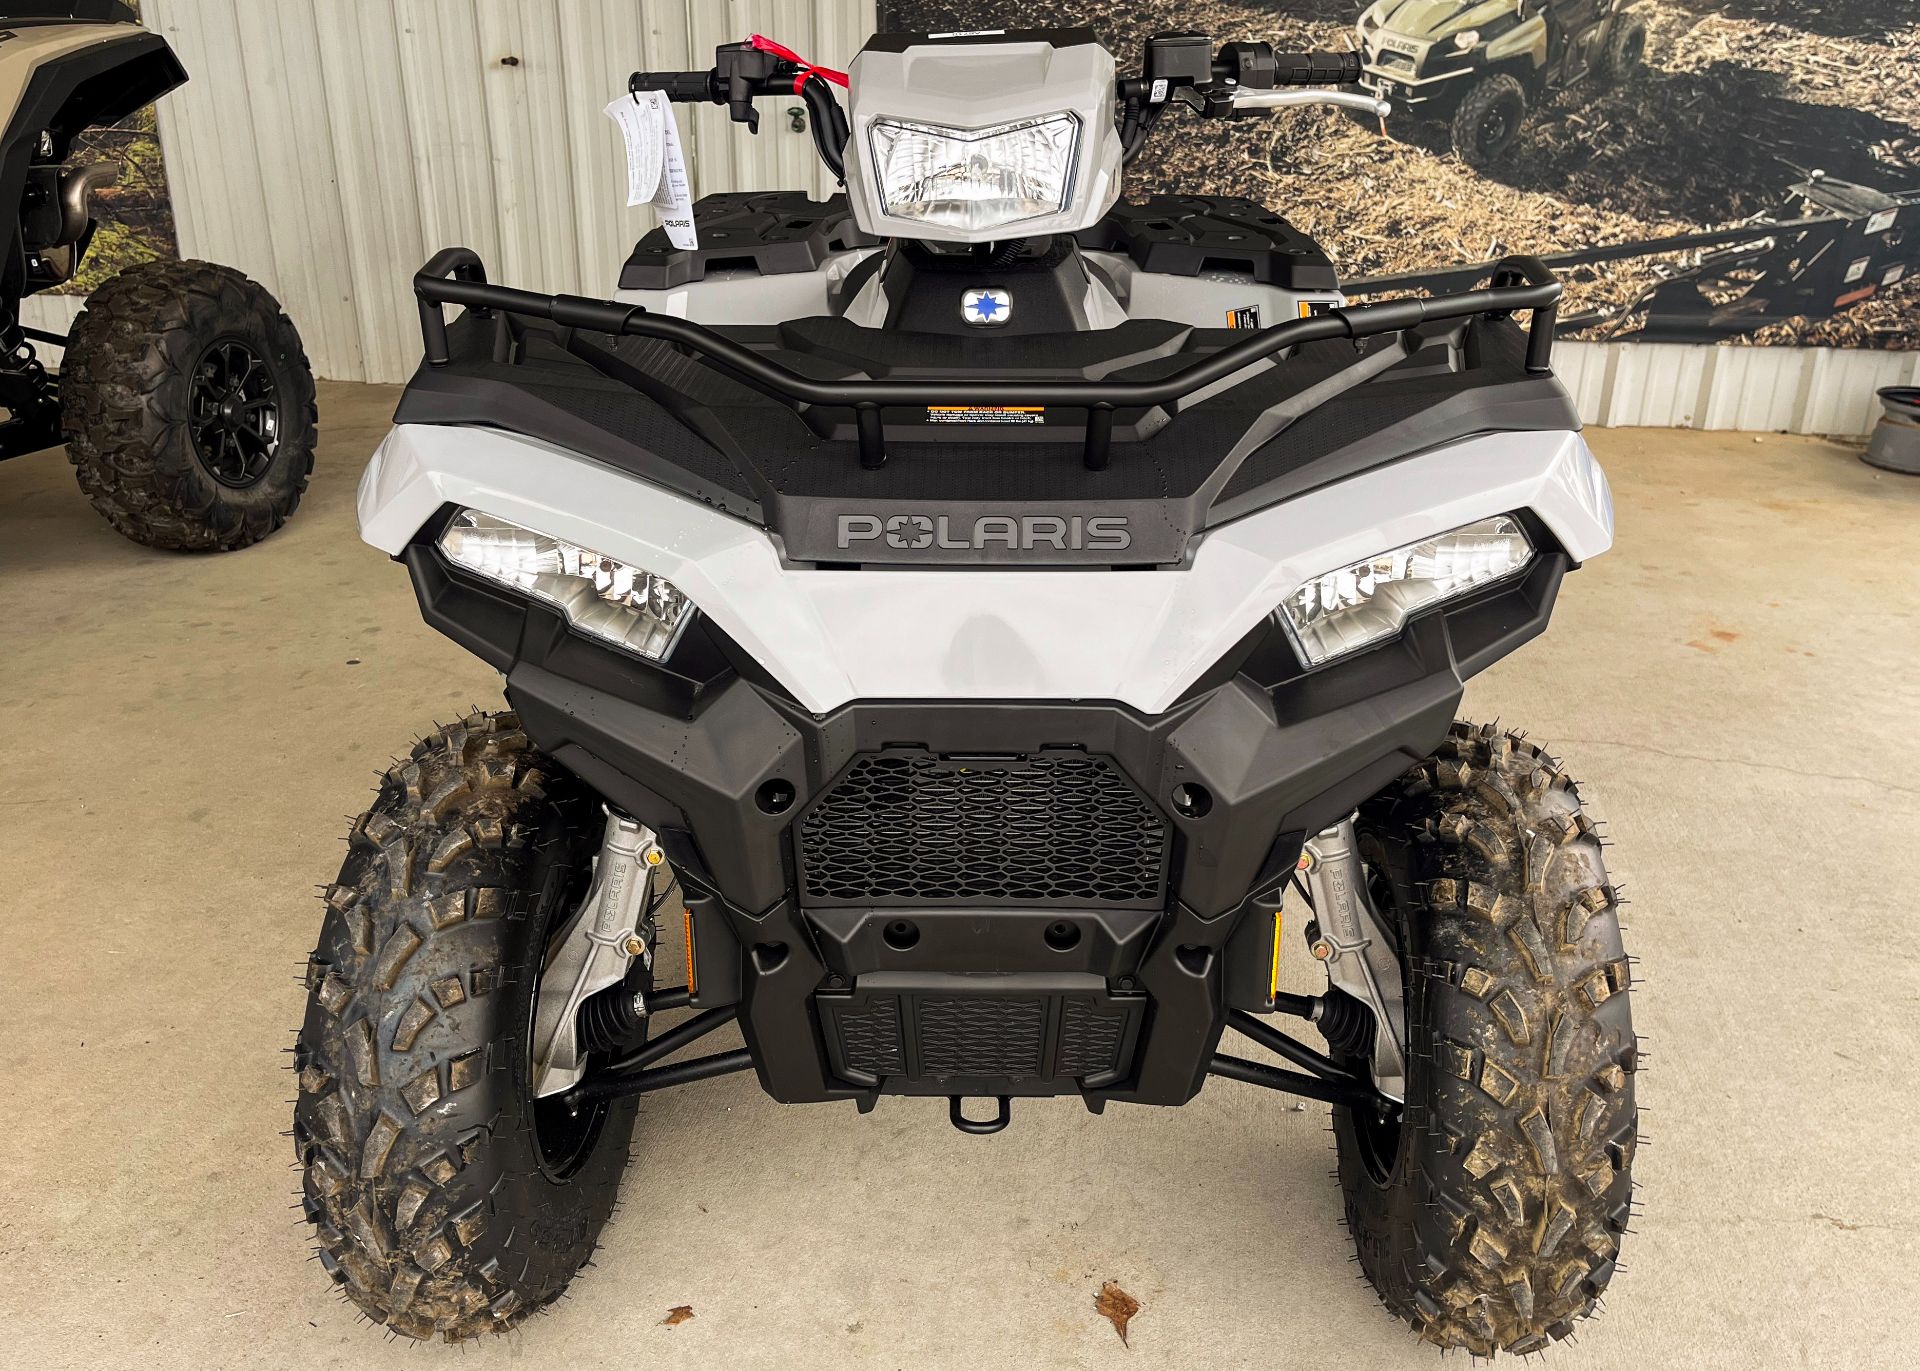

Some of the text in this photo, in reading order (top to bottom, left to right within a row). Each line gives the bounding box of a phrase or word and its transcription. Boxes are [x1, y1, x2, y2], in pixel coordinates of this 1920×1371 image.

[665, 219, 690, 228] POLARIS
[837, 514, 1132, 550] POLARIS
[601, 863, 627, 933] POLARIS
[1330, 868, 1355, 938] POLARIS
